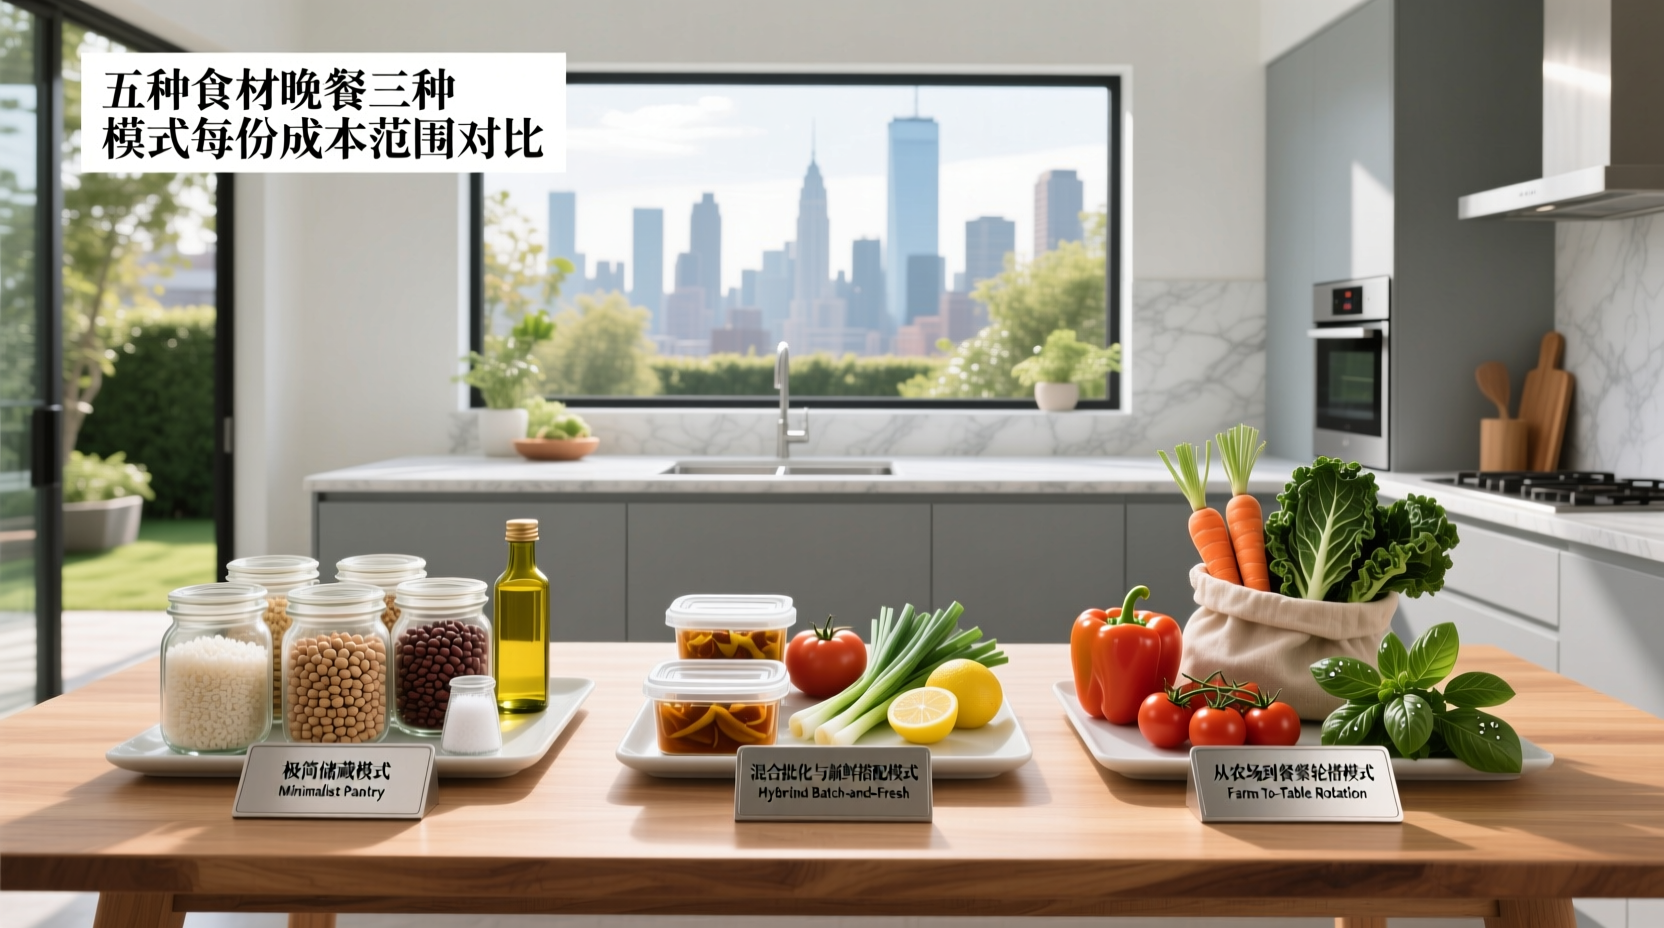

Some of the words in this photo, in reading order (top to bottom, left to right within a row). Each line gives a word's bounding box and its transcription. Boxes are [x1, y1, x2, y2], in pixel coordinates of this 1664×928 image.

[278, 784, 341, 797] Minimalist
[344, 785, 385, 802] Pantry
[1227, 786, 1259, 799] Farm
[1315, 786, 1368, 800] Rotation
